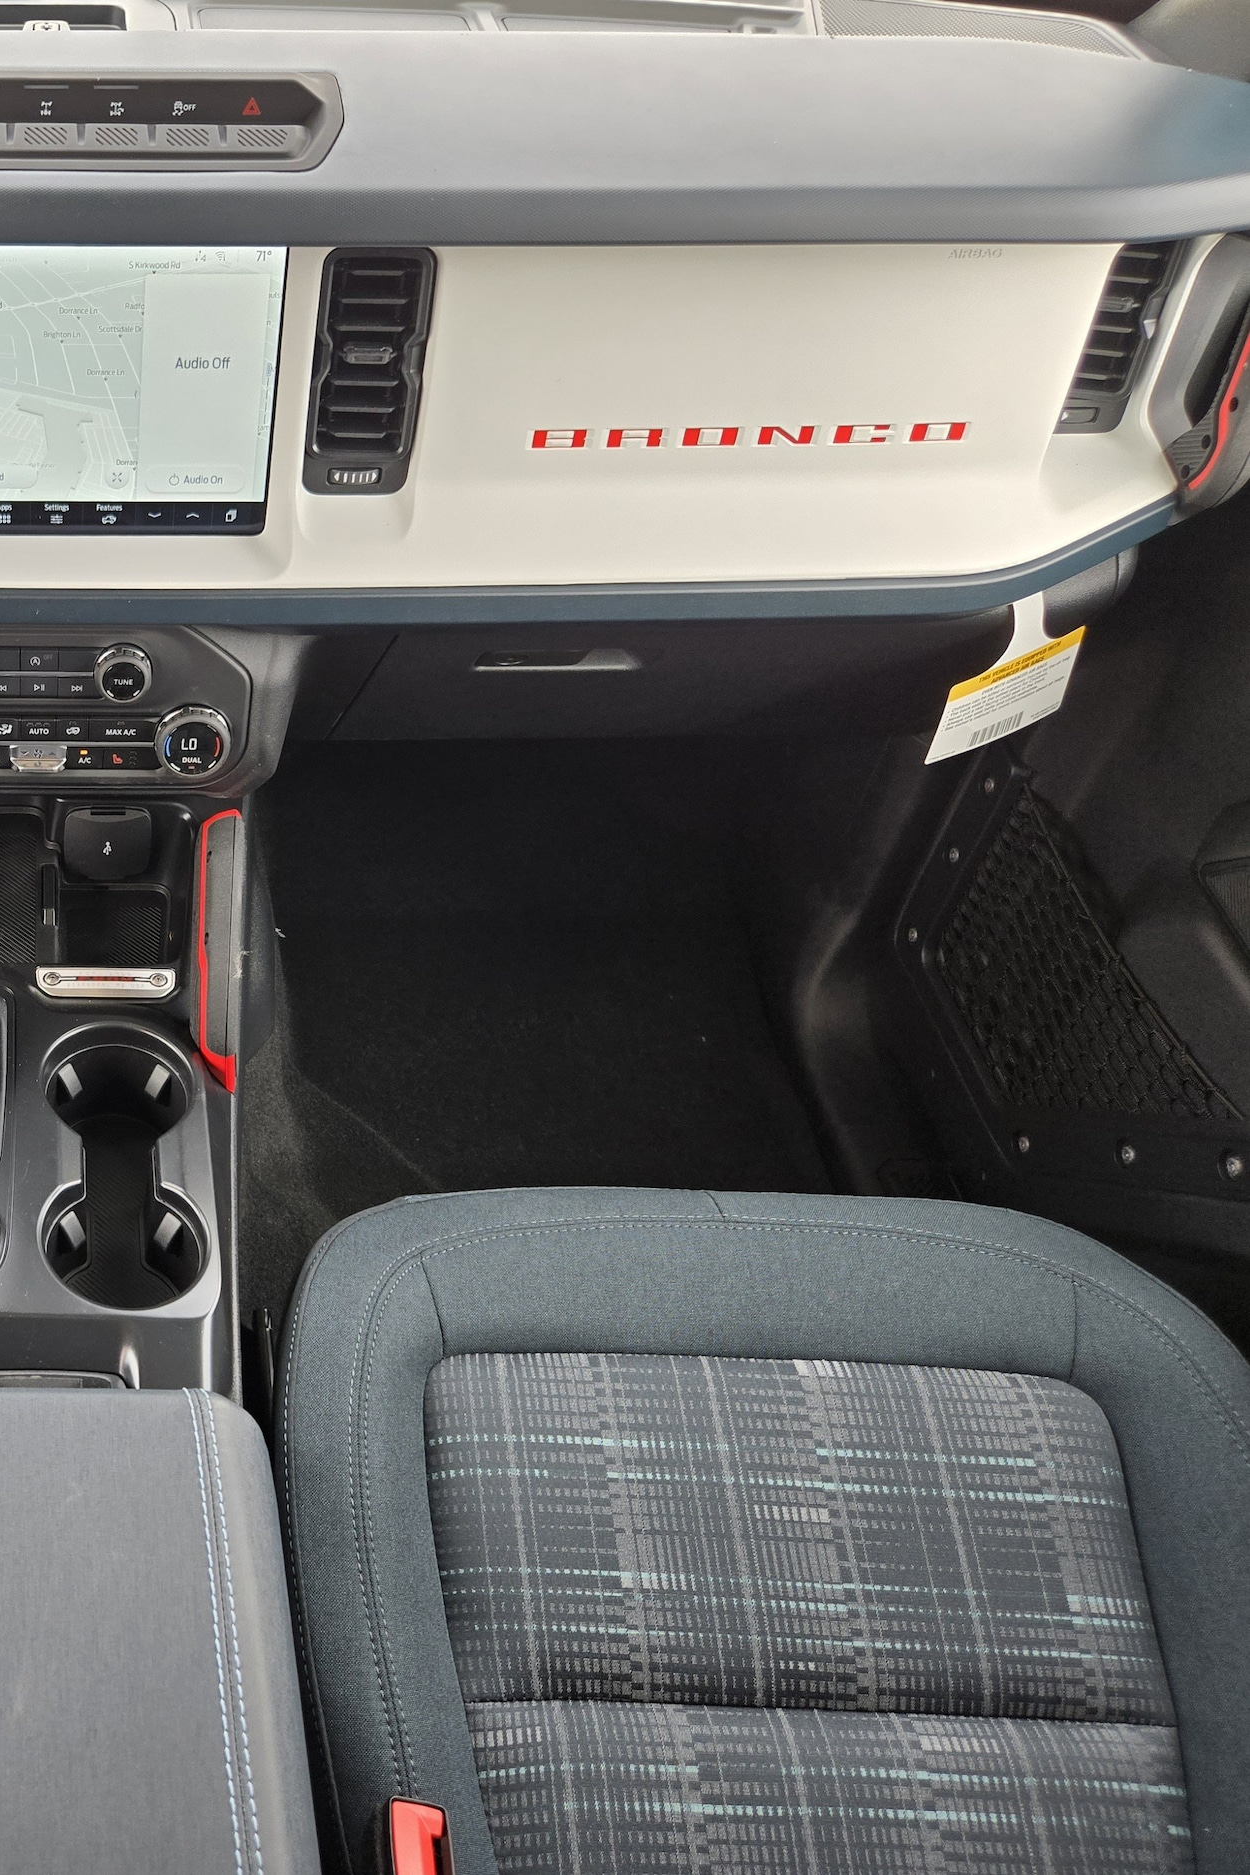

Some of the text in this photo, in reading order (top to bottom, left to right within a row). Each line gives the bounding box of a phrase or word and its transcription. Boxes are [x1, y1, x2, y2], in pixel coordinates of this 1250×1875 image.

[183, 102, 197, 112] OFF
[256, 251, 272, 262] 71°
[947, 247, 1003, 260] AIRBAG
[134, 261, 169, 269] Kirkwood
[59, 307, 98, 315] Dorrance Ln
[43, 331, 71, 339] Brighton
[175, 357, 231, 369] Audio Off
[525, 421, 972, 450] BRONCO
[184, 475, 223, 484] Audio On
[44, 504, 70, 512] Settings
[113, 678, 134, 686] TUNE
